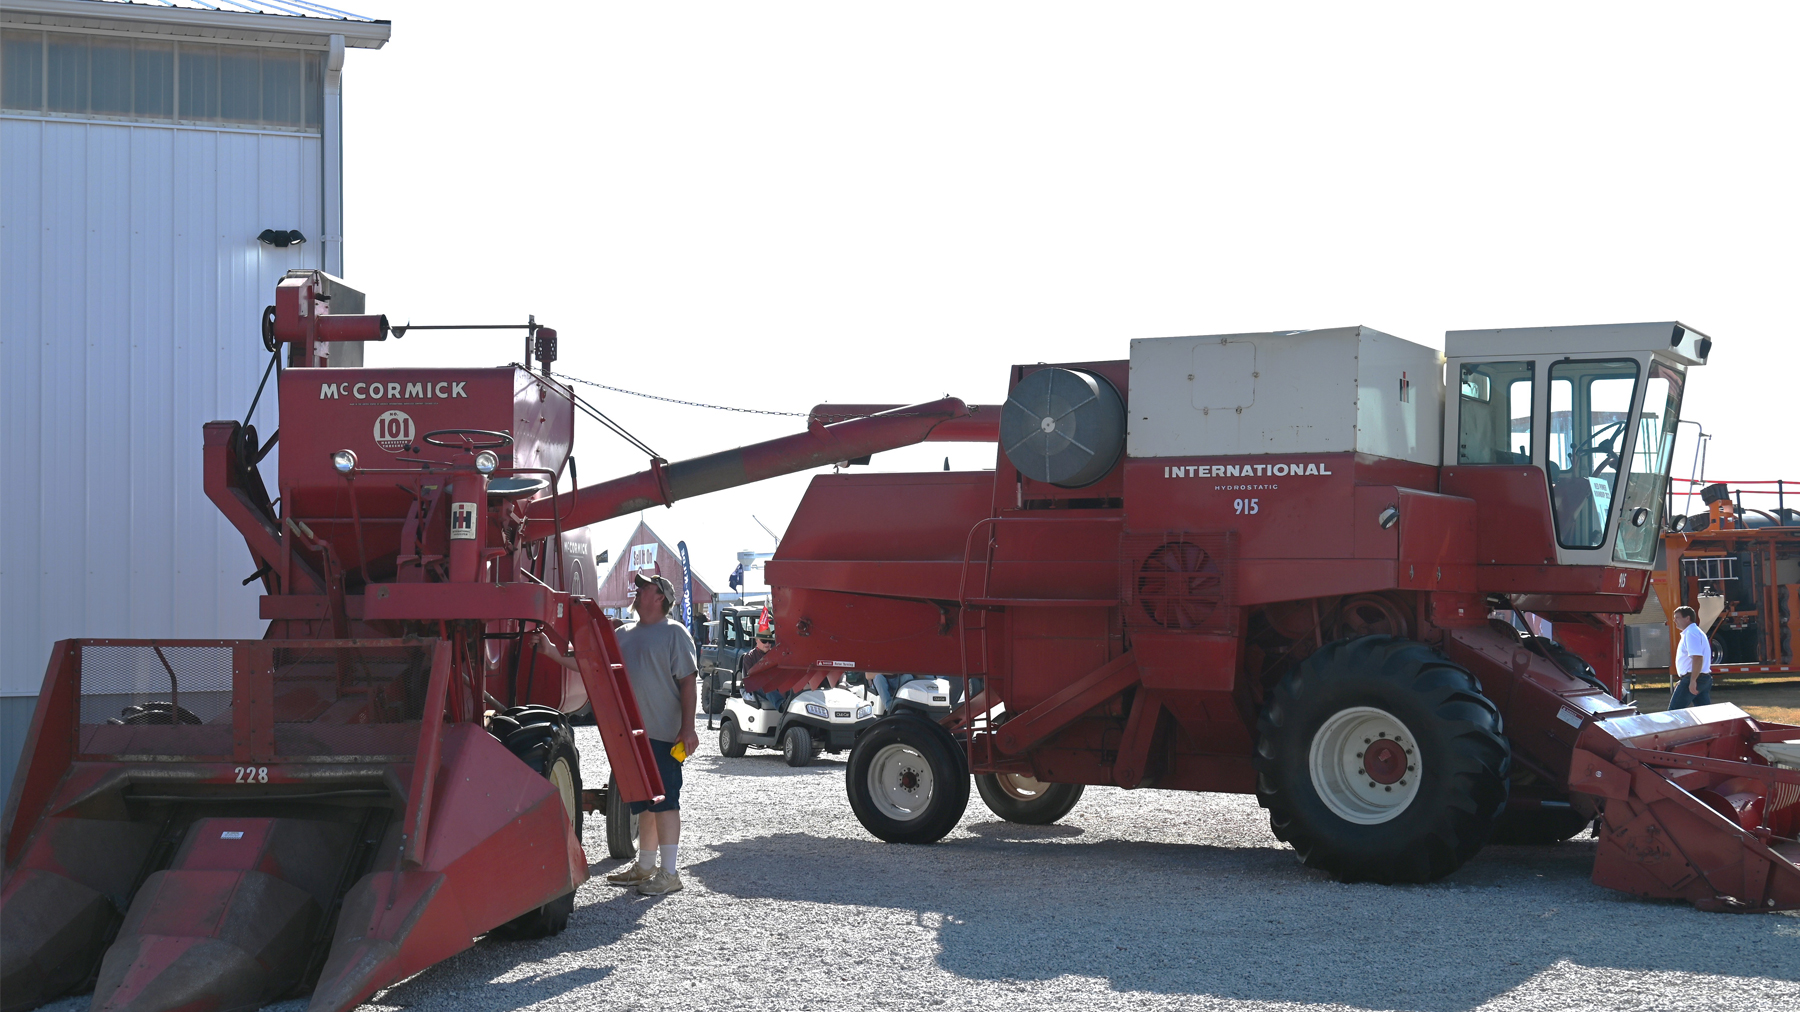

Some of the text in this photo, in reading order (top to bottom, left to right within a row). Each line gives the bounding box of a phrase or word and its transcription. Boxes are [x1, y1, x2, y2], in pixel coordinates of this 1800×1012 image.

[379, 417, 410, 439] 101
[1164, 463, 1332, 478] INTERNATIONAL
[1233, 498, 1259, 515] 915
[1618, 572, 1627, 588] 915
[234, 766, 269, 784] 228
